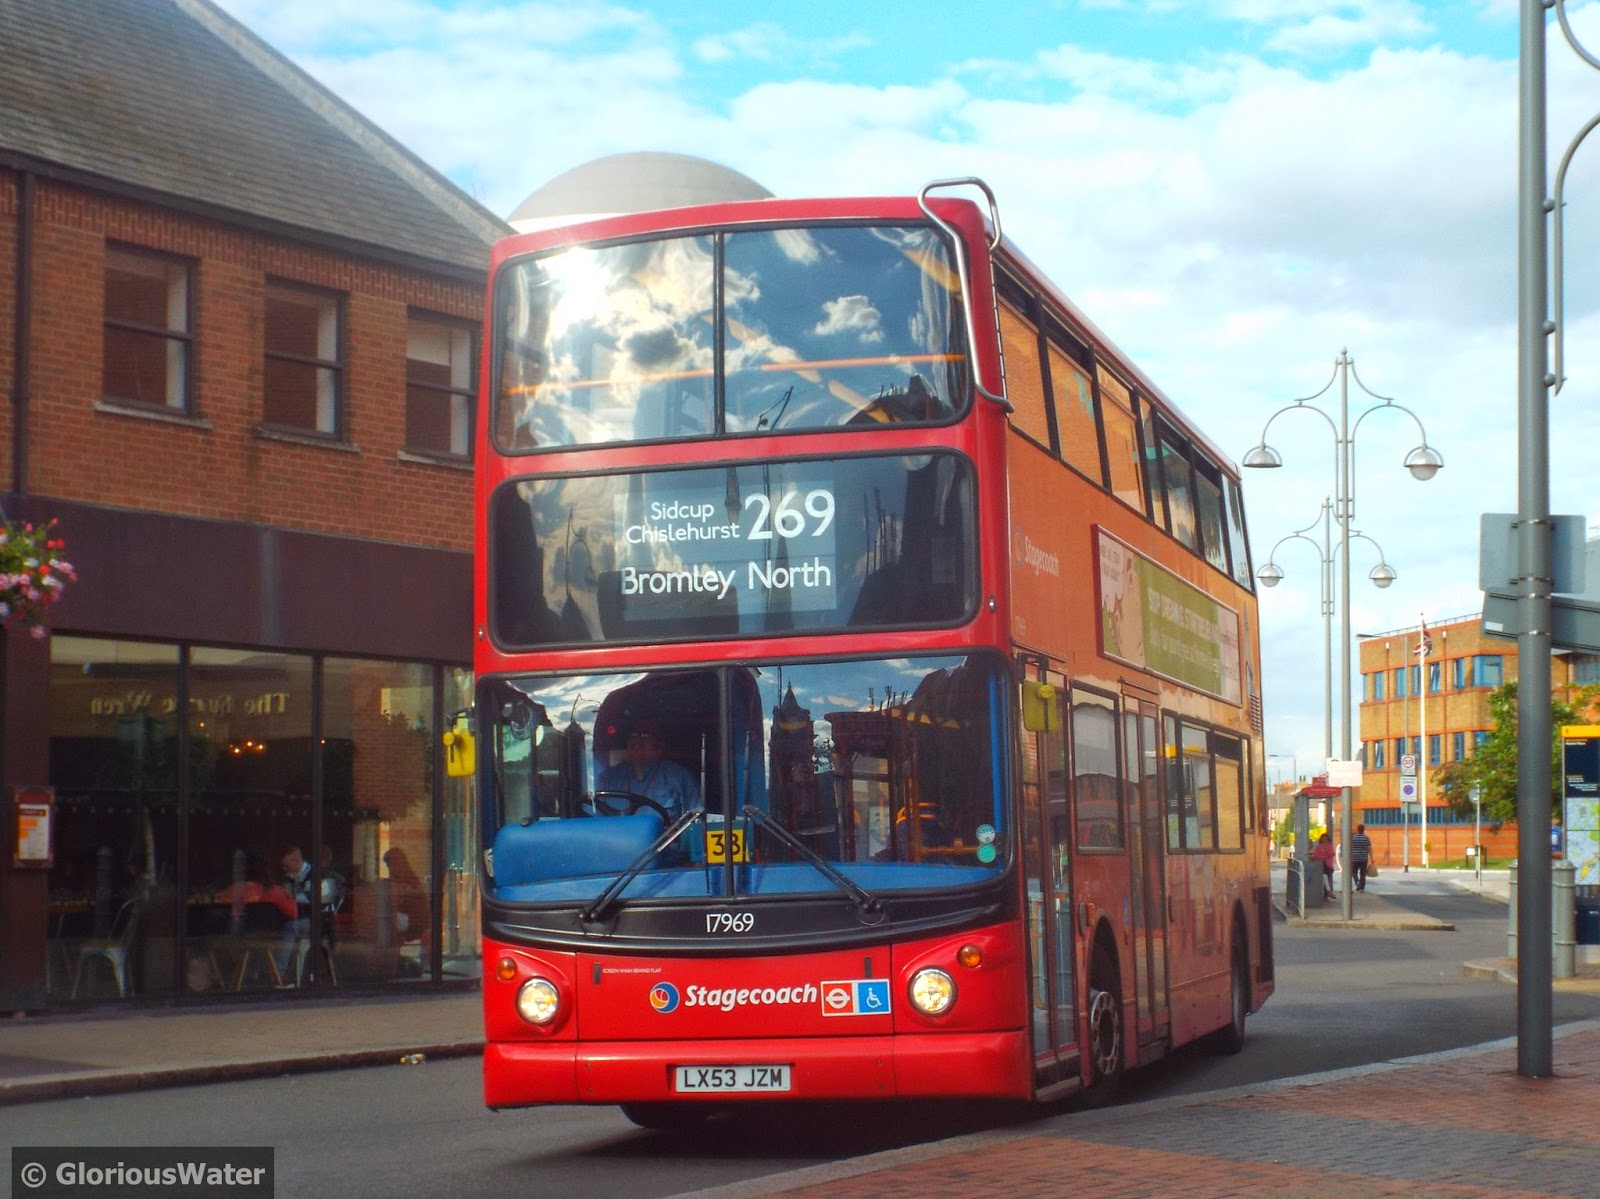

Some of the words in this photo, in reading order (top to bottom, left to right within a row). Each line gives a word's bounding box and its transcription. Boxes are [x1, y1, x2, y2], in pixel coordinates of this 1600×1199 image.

[650, 500, 715, 523] Sidcup
[744, 488, 836, 540] 269
[625, 522, 741, 544] Chislehurst
[621, 564, 736, 600] Bromley
[748, 556, 832, 590] North
[706, 912, 755, 933] 17969
[685, 983, 818, 1012] Stagecoach
[684, 1069, 736, 1088] LX53
[744, 1068, 782, 1087] JZM
